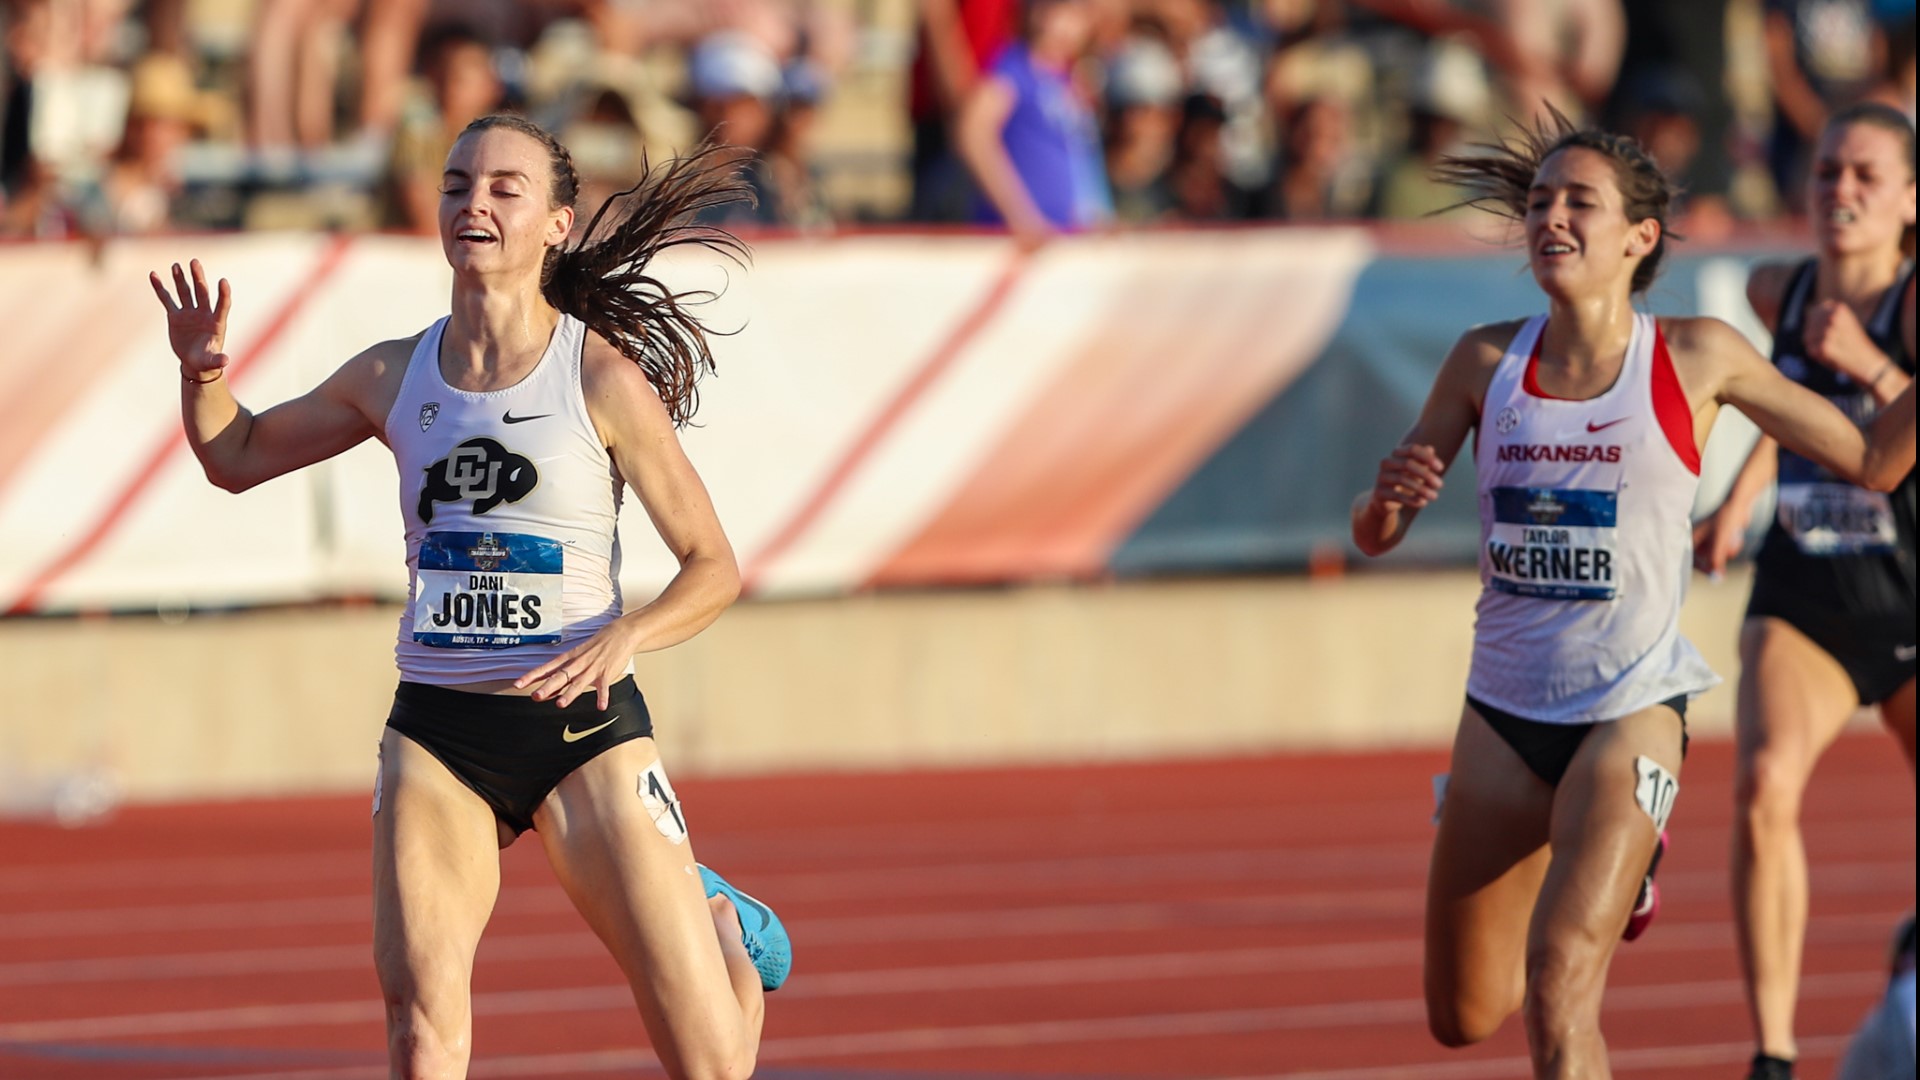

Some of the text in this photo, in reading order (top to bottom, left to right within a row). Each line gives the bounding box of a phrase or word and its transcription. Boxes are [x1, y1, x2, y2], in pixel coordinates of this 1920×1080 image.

[1496, 444, 1622, 463] ARKANSAS
[445, 446, 502, 499] CU
[1522, 528, 1570, 544] TAYLOR
[1488, 542, 1612, 581] WERNER
[469, 575, 503, 591] DANI
[432, 593, 541, 629] JONES
[648, 770, 685, 834] 1
[1648, 769, 1674, 827] 10
